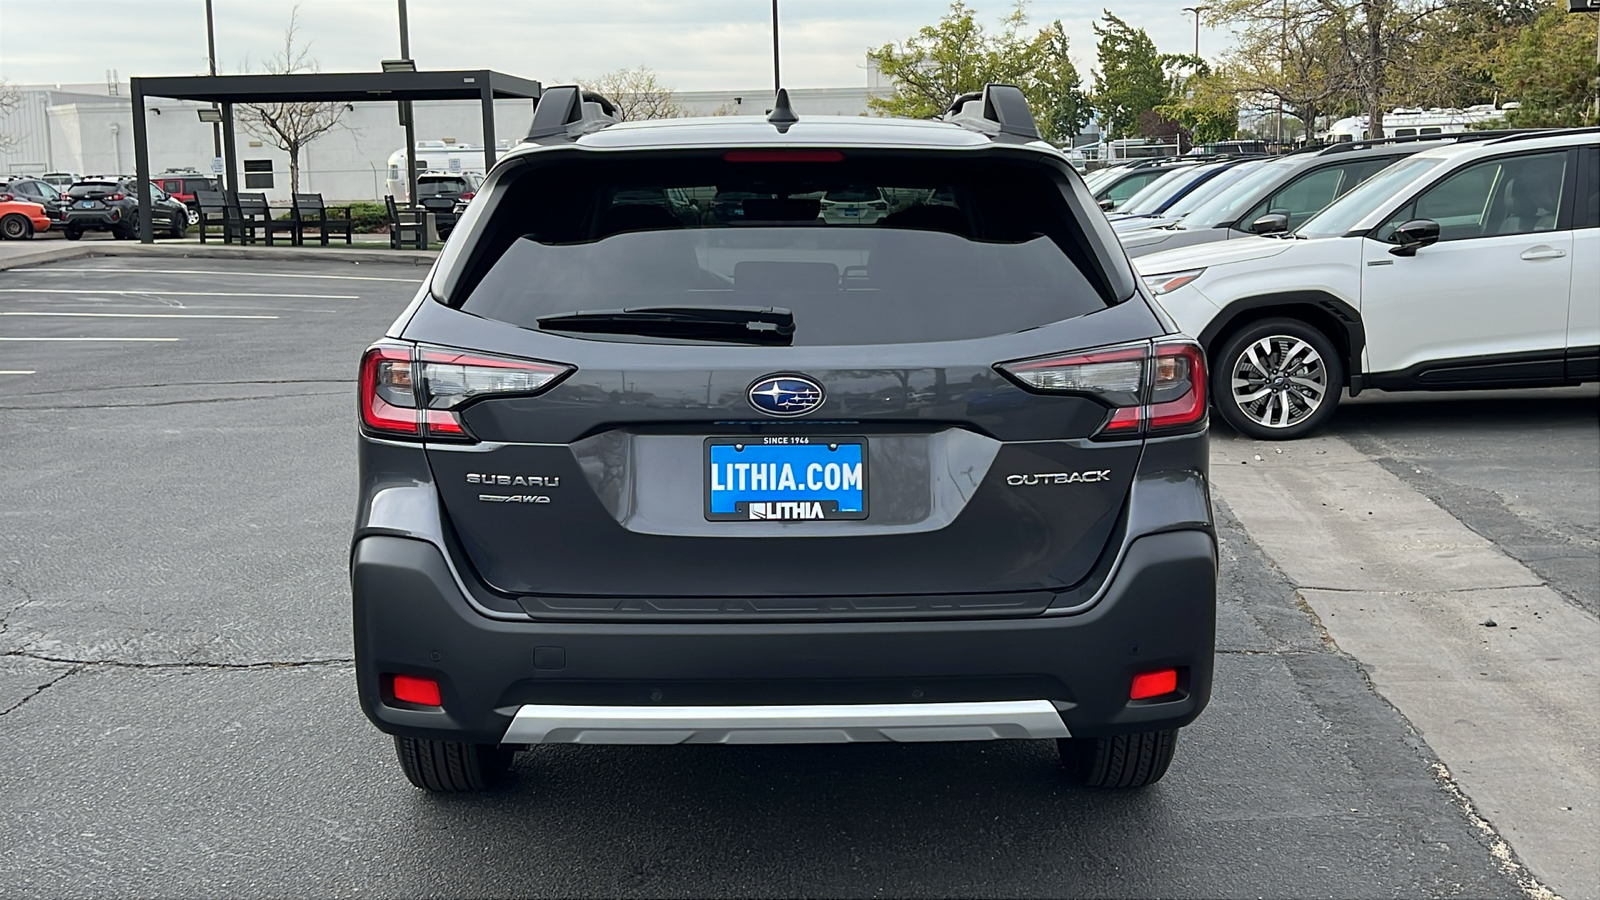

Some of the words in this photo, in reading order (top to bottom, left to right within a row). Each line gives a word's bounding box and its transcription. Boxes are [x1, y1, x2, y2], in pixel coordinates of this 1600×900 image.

[763, 437, 789, 445] SINCE
[466, 473, 560, 487] SUBARU
[711, 462, 863, 491] LITHIA.COM
[1006, 469, 1111, 486] OUTBACK
[505, 495, 551, 504] AWD
[767, 501, 825, 520] LITHIA
